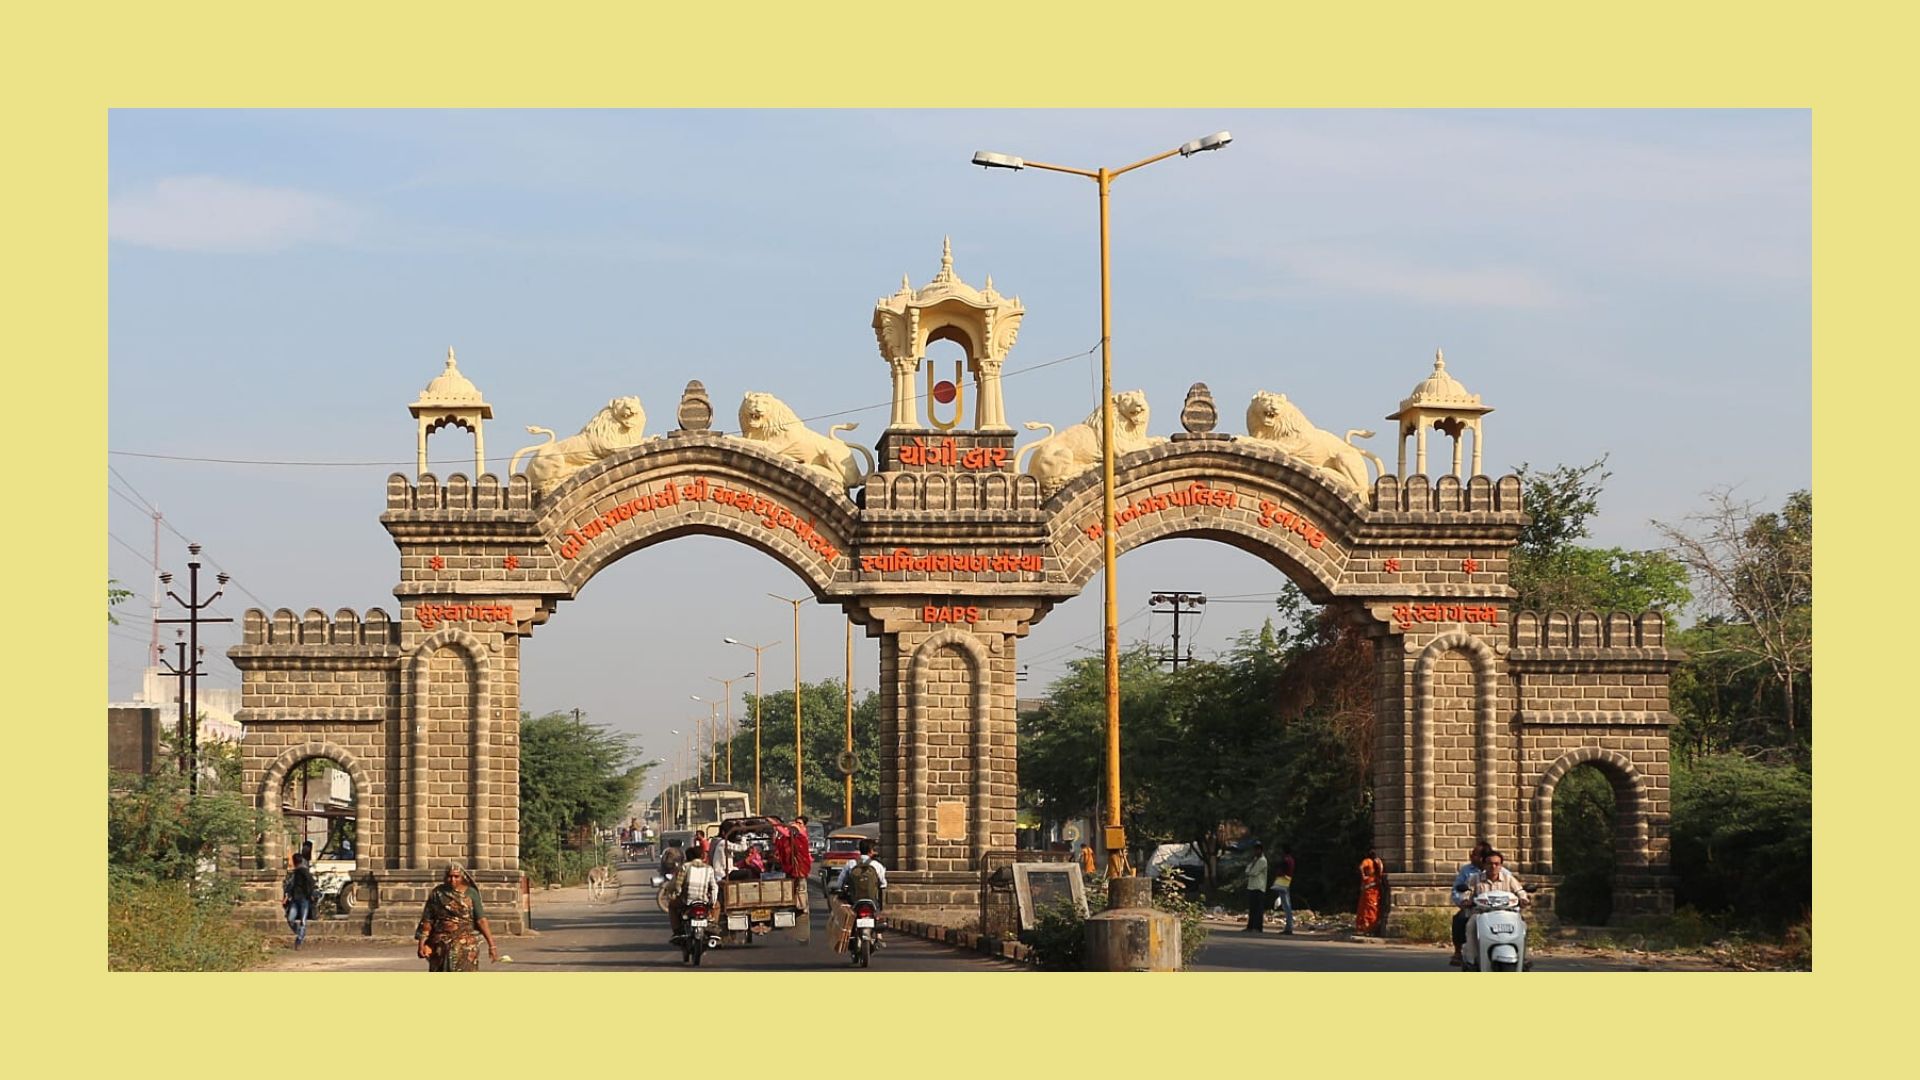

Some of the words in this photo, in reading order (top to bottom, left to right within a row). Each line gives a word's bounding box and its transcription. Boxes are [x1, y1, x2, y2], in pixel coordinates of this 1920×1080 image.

[899, 436, 957, 466] યોગી
[962, 446, 1009, 469] દ્વાર
[682, 476, 709, 502] શ્રી
[861, 547, 989, 574] સ્વામિનારાયણ
[991, 549, 1042, 573] સંસ્થા
[923, 605, 980, 624] BAPS
